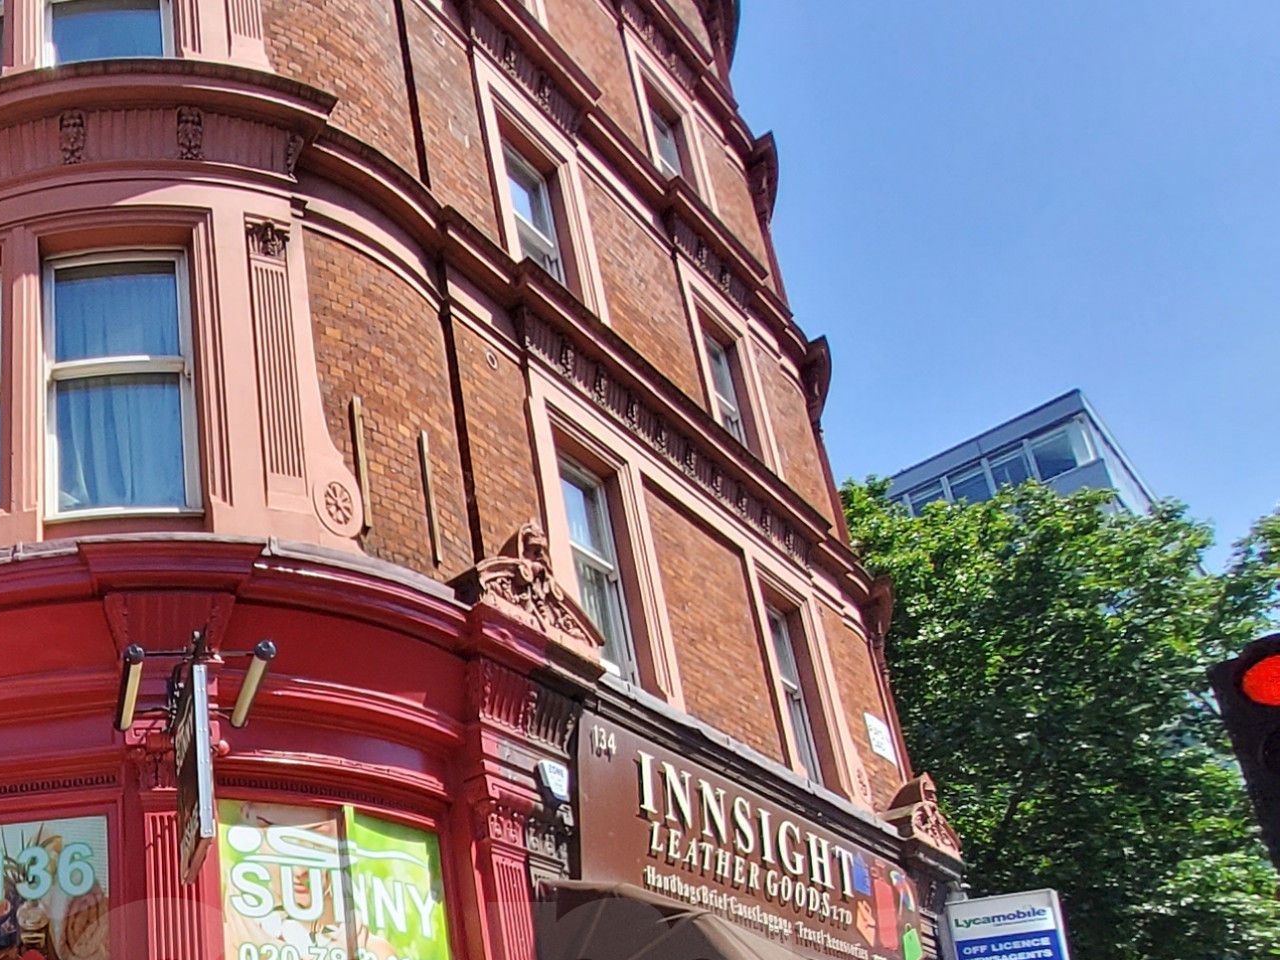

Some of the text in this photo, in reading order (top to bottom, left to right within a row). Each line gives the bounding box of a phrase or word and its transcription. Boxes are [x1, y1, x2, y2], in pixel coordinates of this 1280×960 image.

[592, 724, 617, 754] 134
[637, 750, 855, 898] INNSIGHT
[229, 861, 437, 938] SUNNY
[650, 821, 853, 925] LEATHER GOODS LTD
[954, 908, 1047, 929] Lycamobile
[963, 937, 1051, 956] OFF LICENCE
